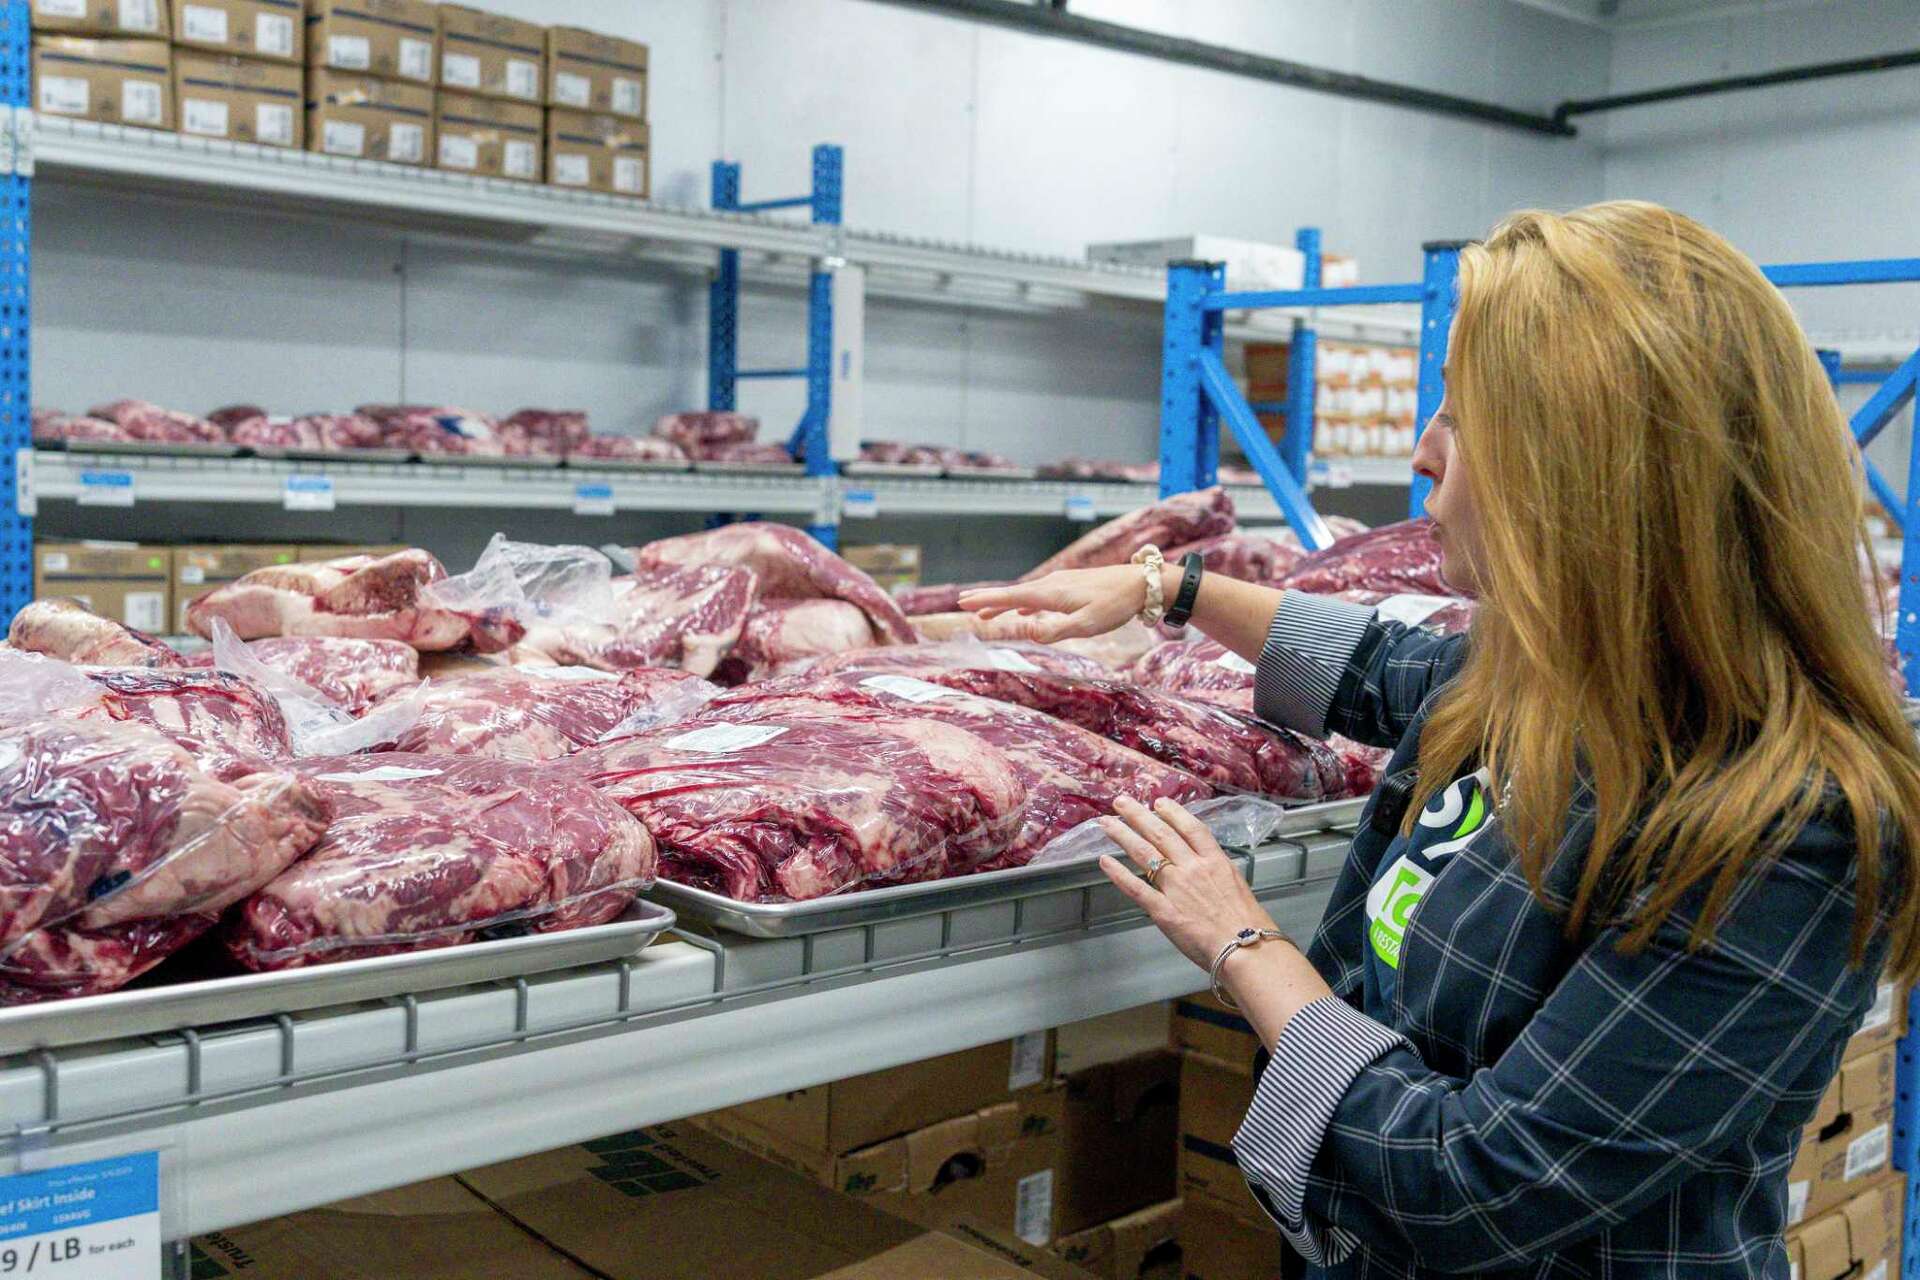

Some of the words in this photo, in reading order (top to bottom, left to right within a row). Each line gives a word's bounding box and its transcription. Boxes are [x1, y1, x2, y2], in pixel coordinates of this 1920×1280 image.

[18, 1196, 50, 1213] Skirt
[54, 1187, 96, 1205] Inside
[50, 1237, 81, 1262] LB
[88, 1244, 105, 1255] for
[108, 1236, 136, 1251] each
